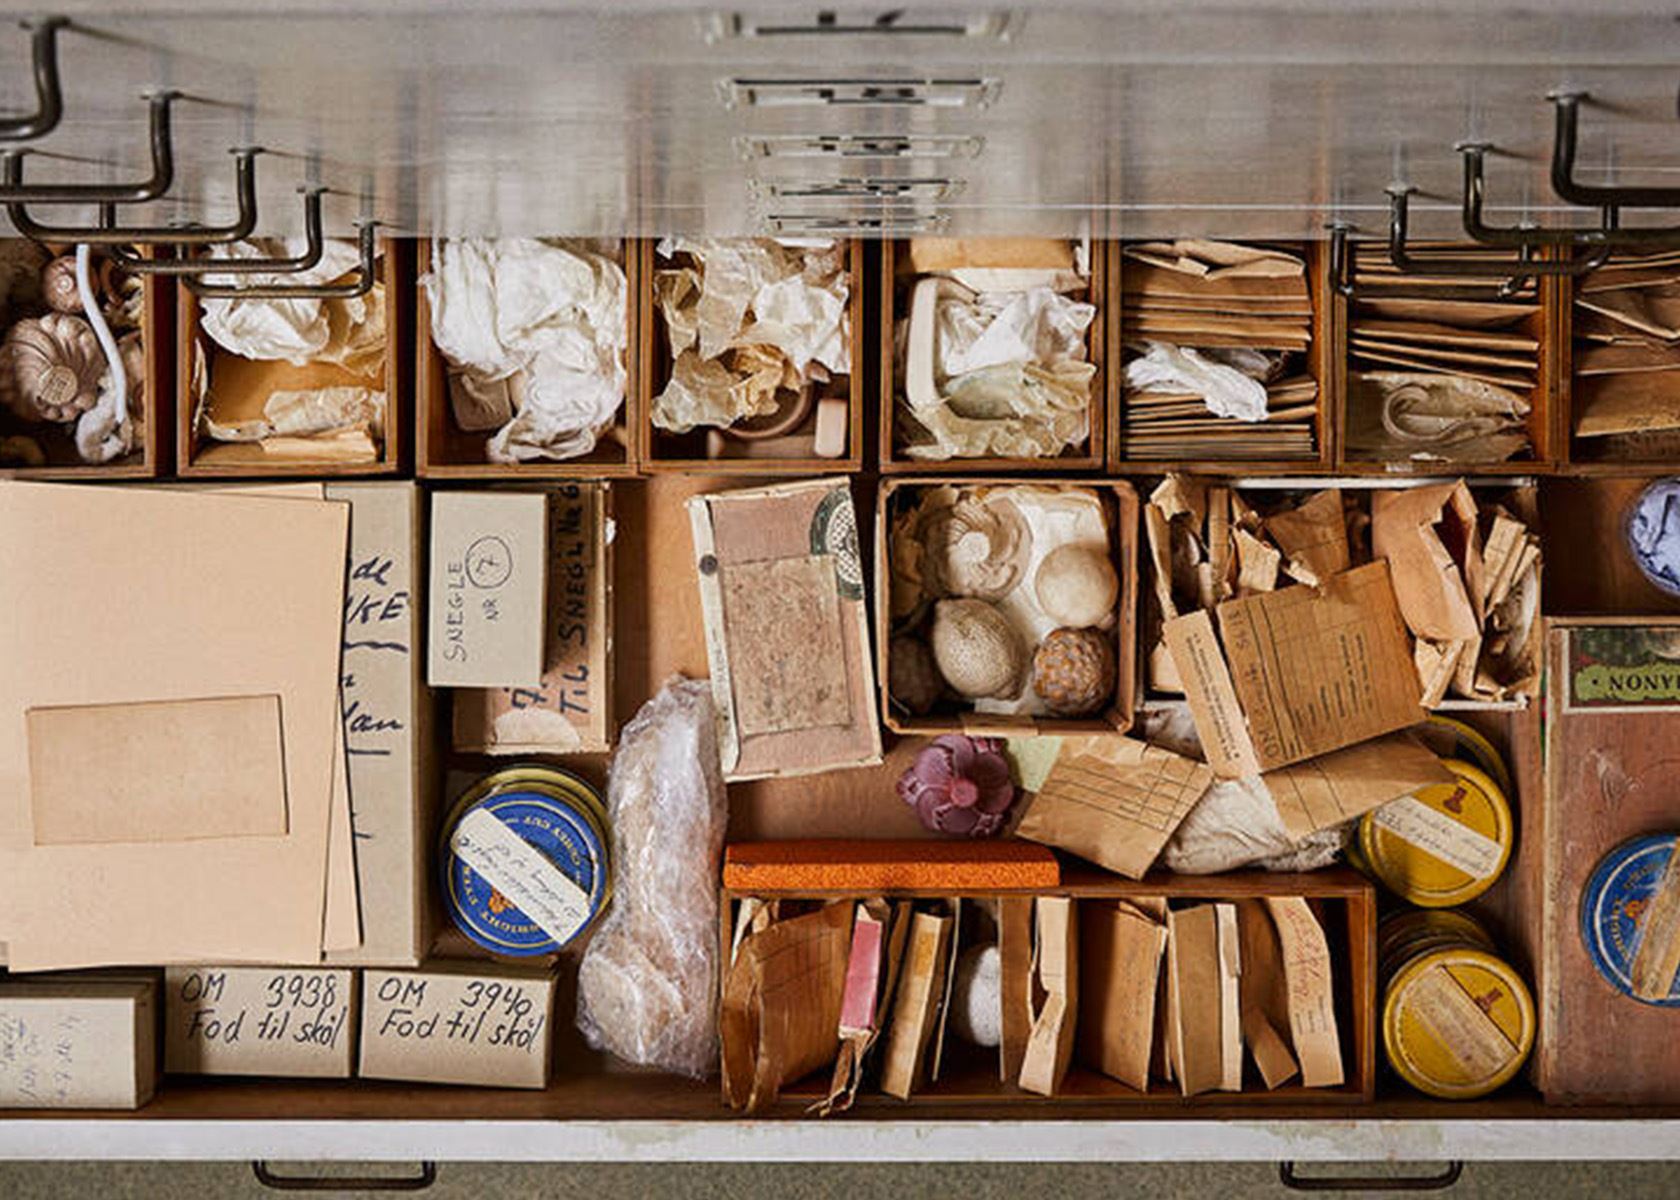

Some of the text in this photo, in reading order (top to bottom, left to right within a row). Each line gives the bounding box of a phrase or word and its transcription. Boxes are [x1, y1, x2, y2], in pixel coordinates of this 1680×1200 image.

[346, 591, 408, 624] KE
[443, 561, 467, 662] SNEGLE
[181, 973, 337, 1008] OM 3938
[378, 977, 533, 1017] OM 3940
[186, 1009, 246, 1044] Fod
[257, 1011, 291, 1040] til
[379, 1008, 440, 1039] Fod
[445, 1010, 487, 1043] til
